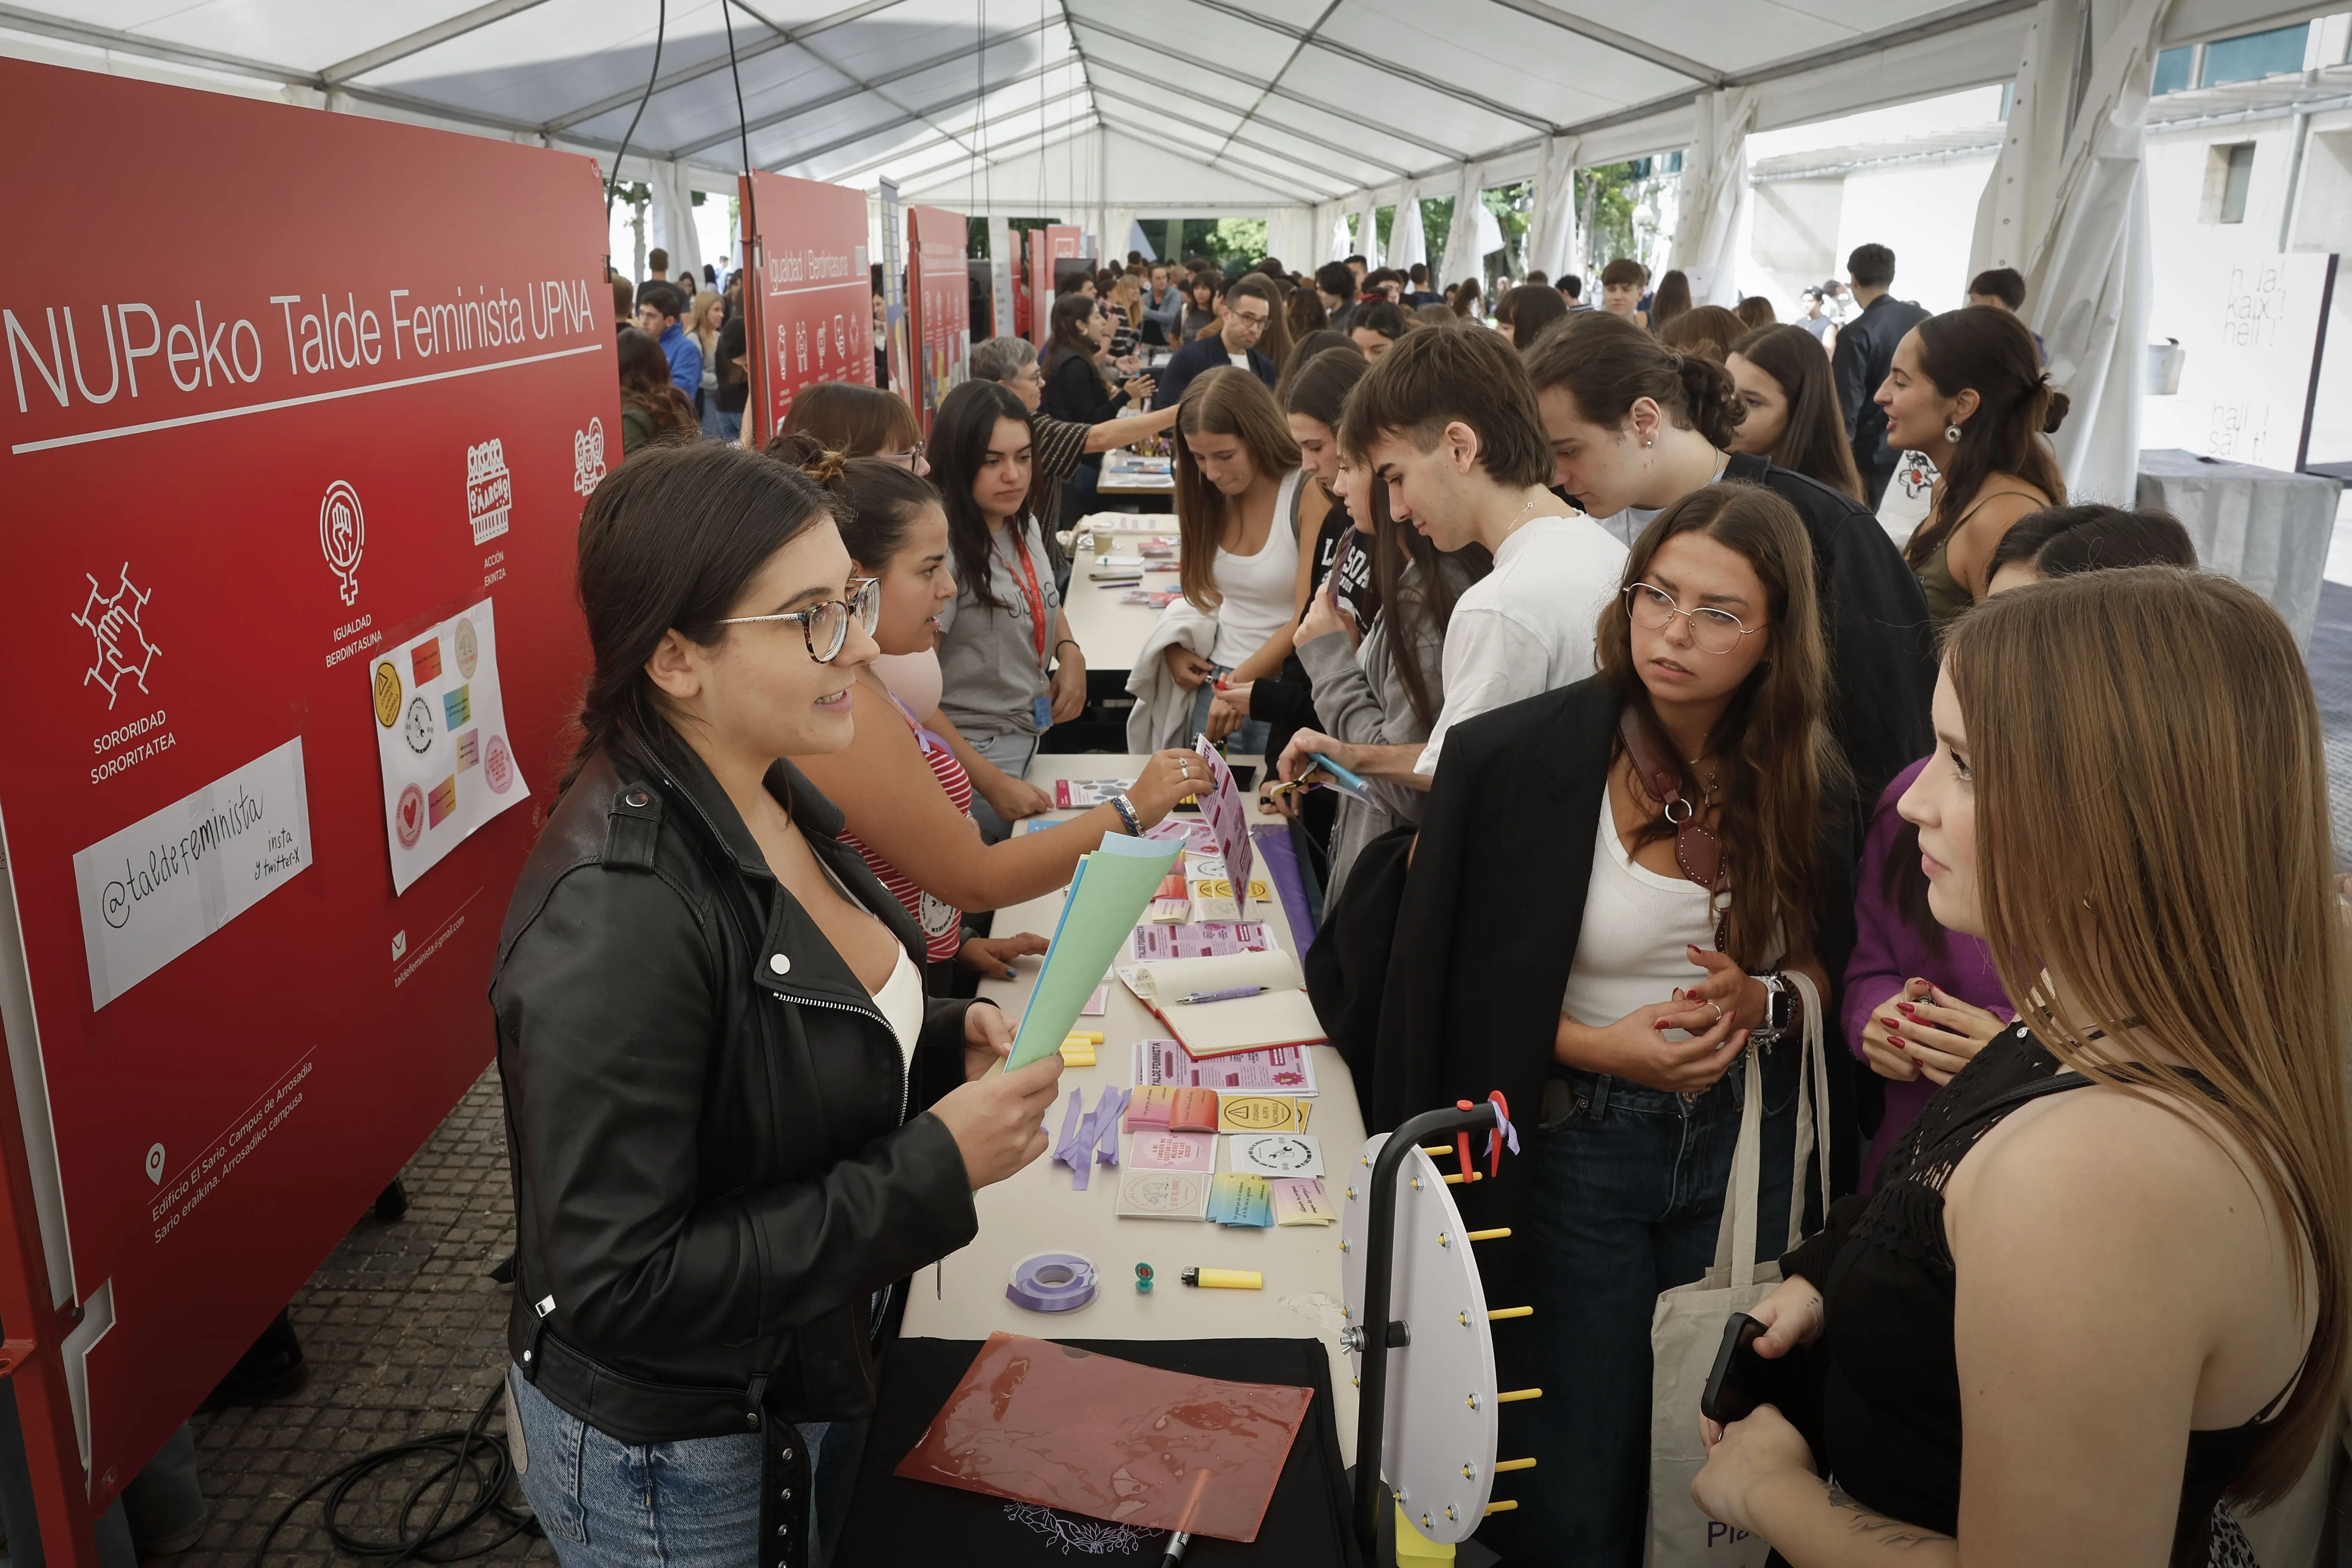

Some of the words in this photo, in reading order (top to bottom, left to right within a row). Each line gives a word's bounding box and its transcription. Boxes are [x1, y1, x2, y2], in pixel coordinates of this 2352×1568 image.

[769, 249, 803, 291] Igualdad
[3, 300, 262, 413] NUPeko
[269, 292, 382, 375] Talde
[390, 285, 525, 360] Feminista
[528, 278, 595, 340] UPNA
[484, 550, 504, 569] ACCIÓN
[484, 568, 506, 586] EKINTZA
[333, 614, 371, 642] IGUALDAD
[326, 630, 382, 668] BERDINTASUNA
[93, 710, 166, 754] SORORIDAD
[90, 732, 176, 784] SORORITATEA
[269, 828, 292, 852] insta
[255, 861, 260, 880] y
[394, 916, 465, 988] taldefeminista@gmail.com
[1152, 1070, 1161, 1086] TALDE
[152, 1178, 189, 1222] Edificio
[191, 1167, 200, 1185] El
[202, 1145, 227, 1173] Sario.
[229, 1110, 262, 1147] Campus
[264, 1098, 275, 1114] de
[276, 1061, 312, 1103] Arrosadia
[154, 1213, 180, 1244] Sario
[182, 1176, 220, 1217] eraikina.
[222, 1127, 267, 1178] Arrosadiko
[269, 1093, 303, 1130] campusa
